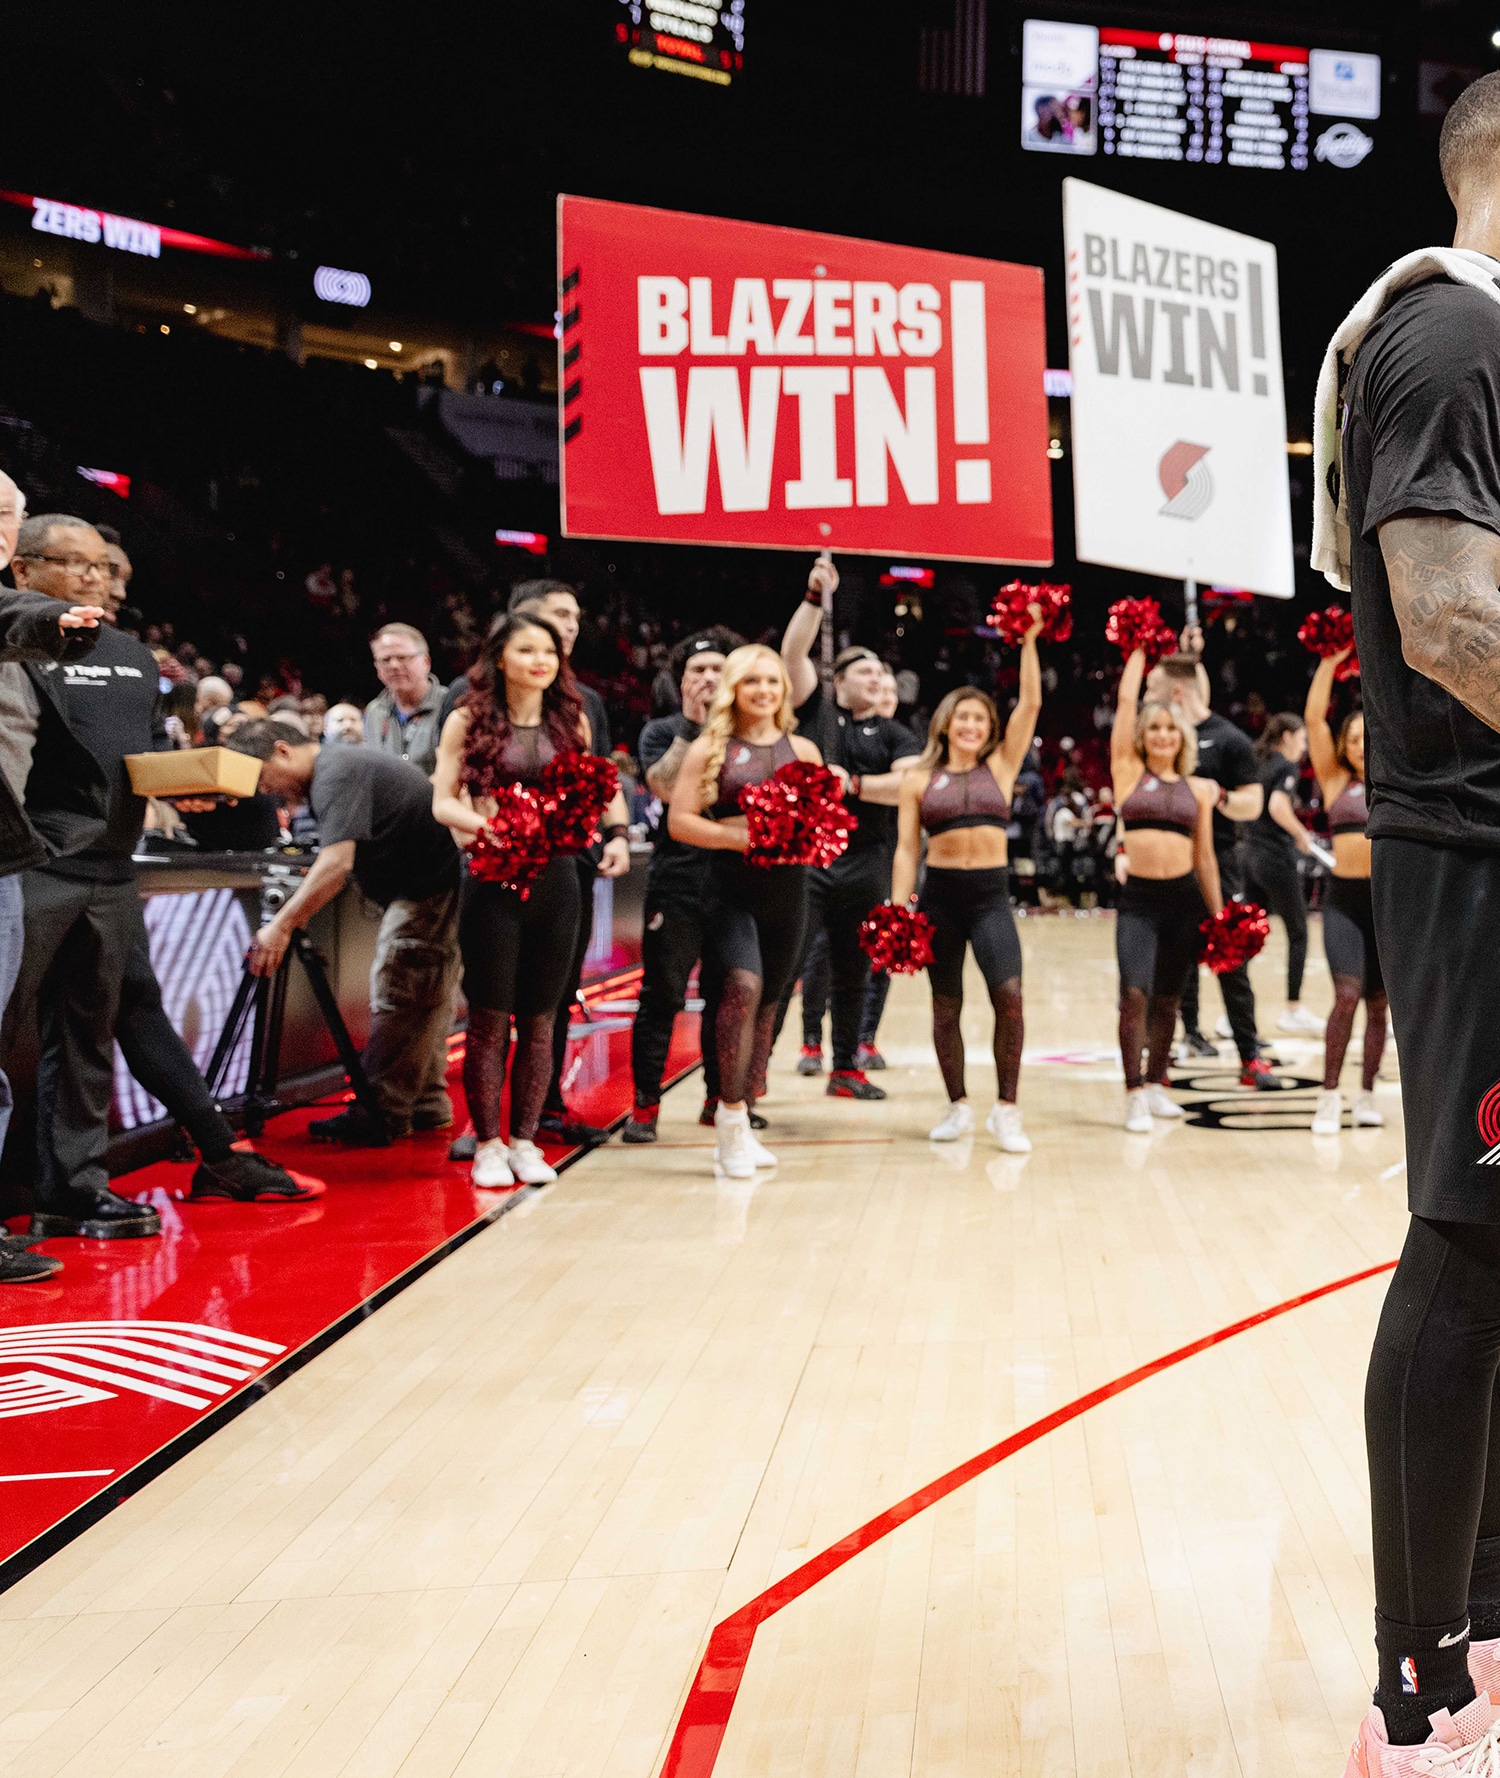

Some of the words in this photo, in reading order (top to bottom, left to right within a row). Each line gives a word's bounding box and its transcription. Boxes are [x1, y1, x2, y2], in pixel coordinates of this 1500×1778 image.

[32, 196, 101, 243] ZERS
[103, 211, 161, 258] WIN
[1084, 233, 1239, 301] BLAZERS
[637, 276, 942, 357] BLAZERS
[1086, 261, 1269, 398] WIN!
[638, 279, 993, 516] WIN!
